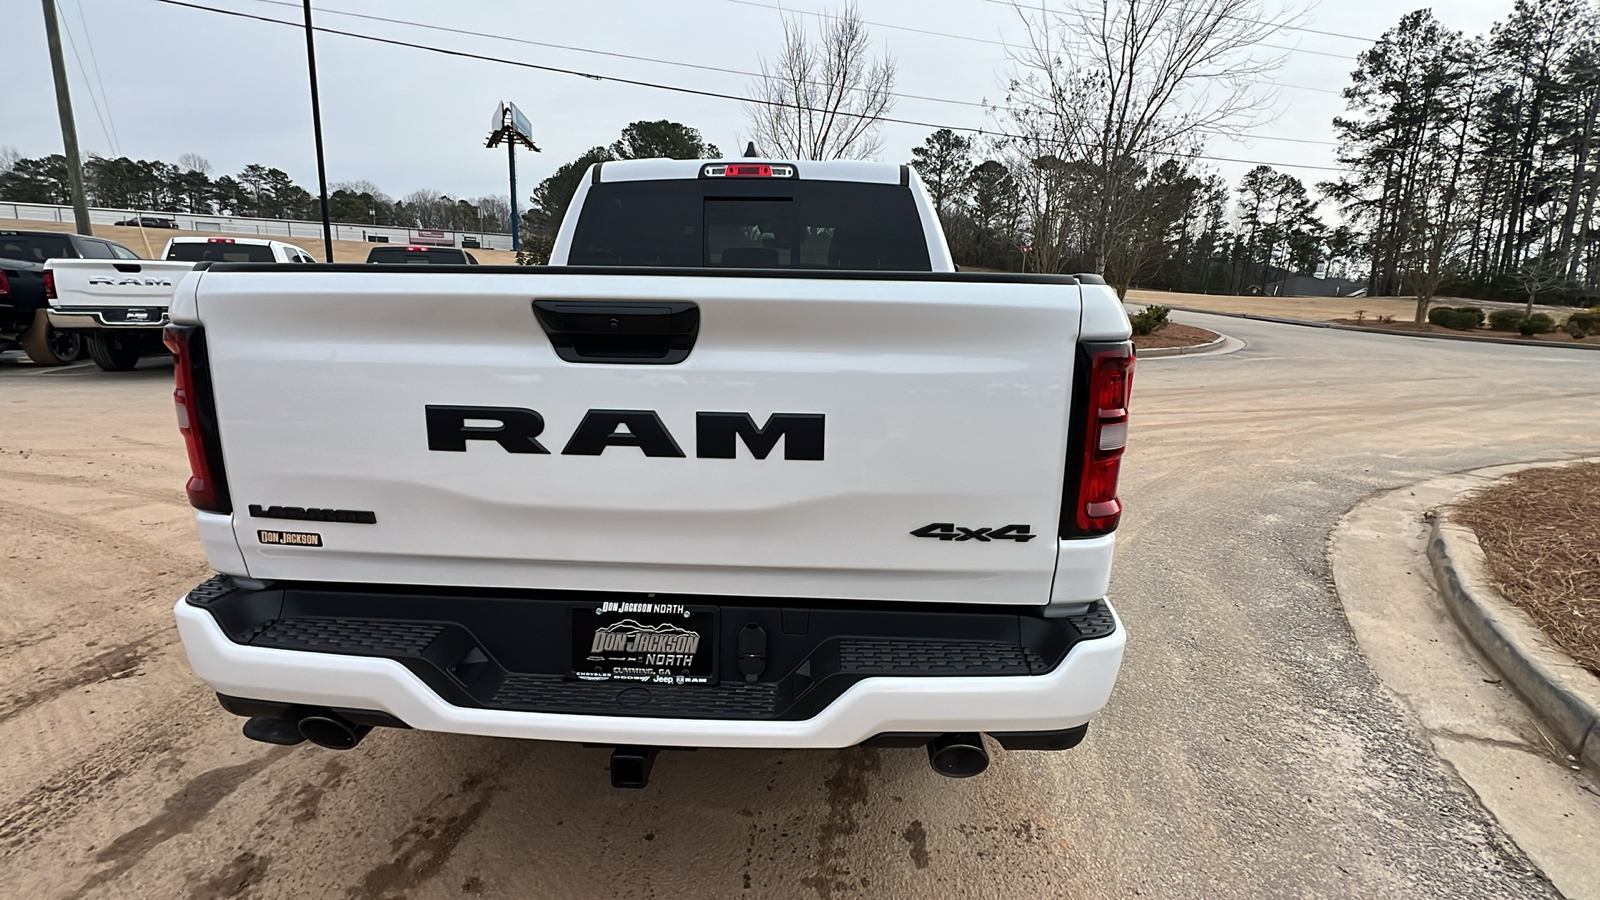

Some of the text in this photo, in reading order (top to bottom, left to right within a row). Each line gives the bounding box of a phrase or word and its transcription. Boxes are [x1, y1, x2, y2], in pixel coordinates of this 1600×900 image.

[88, 275, 172, 286] RAM
[425, 404, 826, 461] RAM
[261, 530, 319, 545] DON JACKSON
[909, 522, 1037, 543] 4x4
[602, 601, 684, 614] DON JACKSON NORTH
[590, 632, 700, 654] DON JACKSON
[645, 654, 693, 667] NORTH
[653, 675, 674, 685] Jeep
